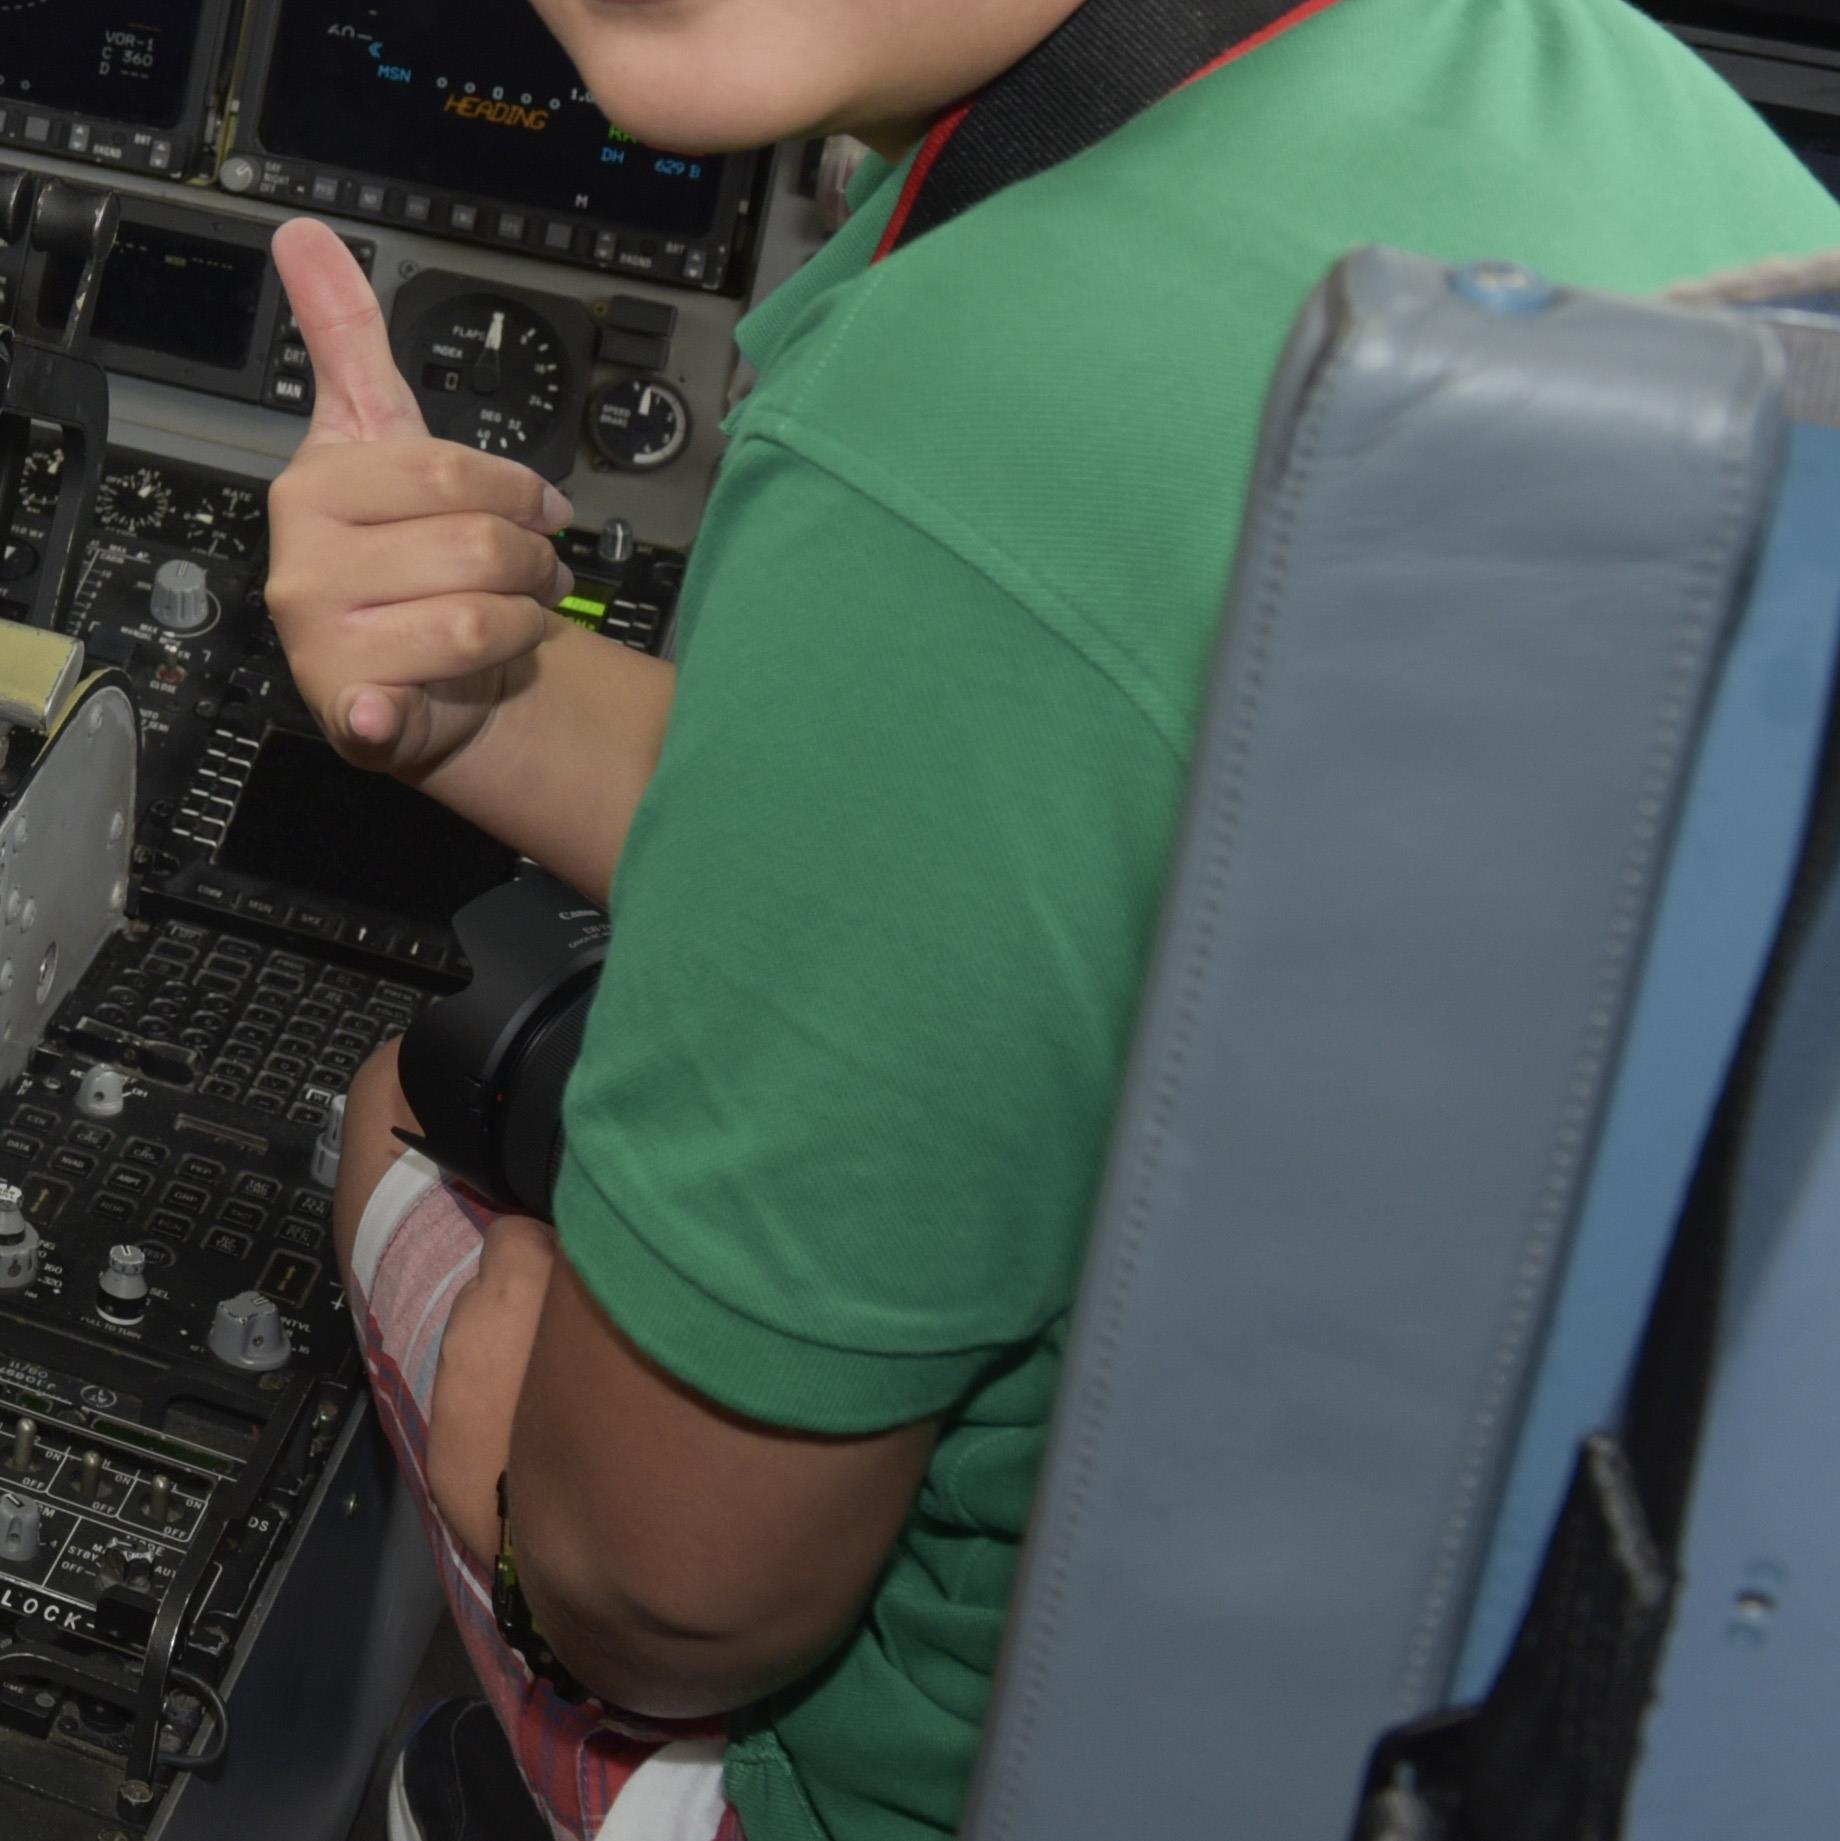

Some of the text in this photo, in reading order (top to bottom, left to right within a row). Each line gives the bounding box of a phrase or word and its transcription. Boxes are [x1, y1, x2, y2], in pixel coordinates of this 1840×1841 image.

[105, 30, 156, 52] VOR-1
[377, 64, 412, 84] MSN
[443, 94, 550, 131] HEADING
[601, 146, 625, 164] DH
[654, 157, 685, 176] 629
[433, 344, 463, 358] INDEX
[275, 381, 303, 399] MAN
[22, 1477, 46, 1491] OFF
[92, 1501, 115, 1515] OFF
[163, 1526, 188, 1540] OFF
[67, 1545, 100, 1562] STBY
[61, 1561, 85, 1574] OFF
